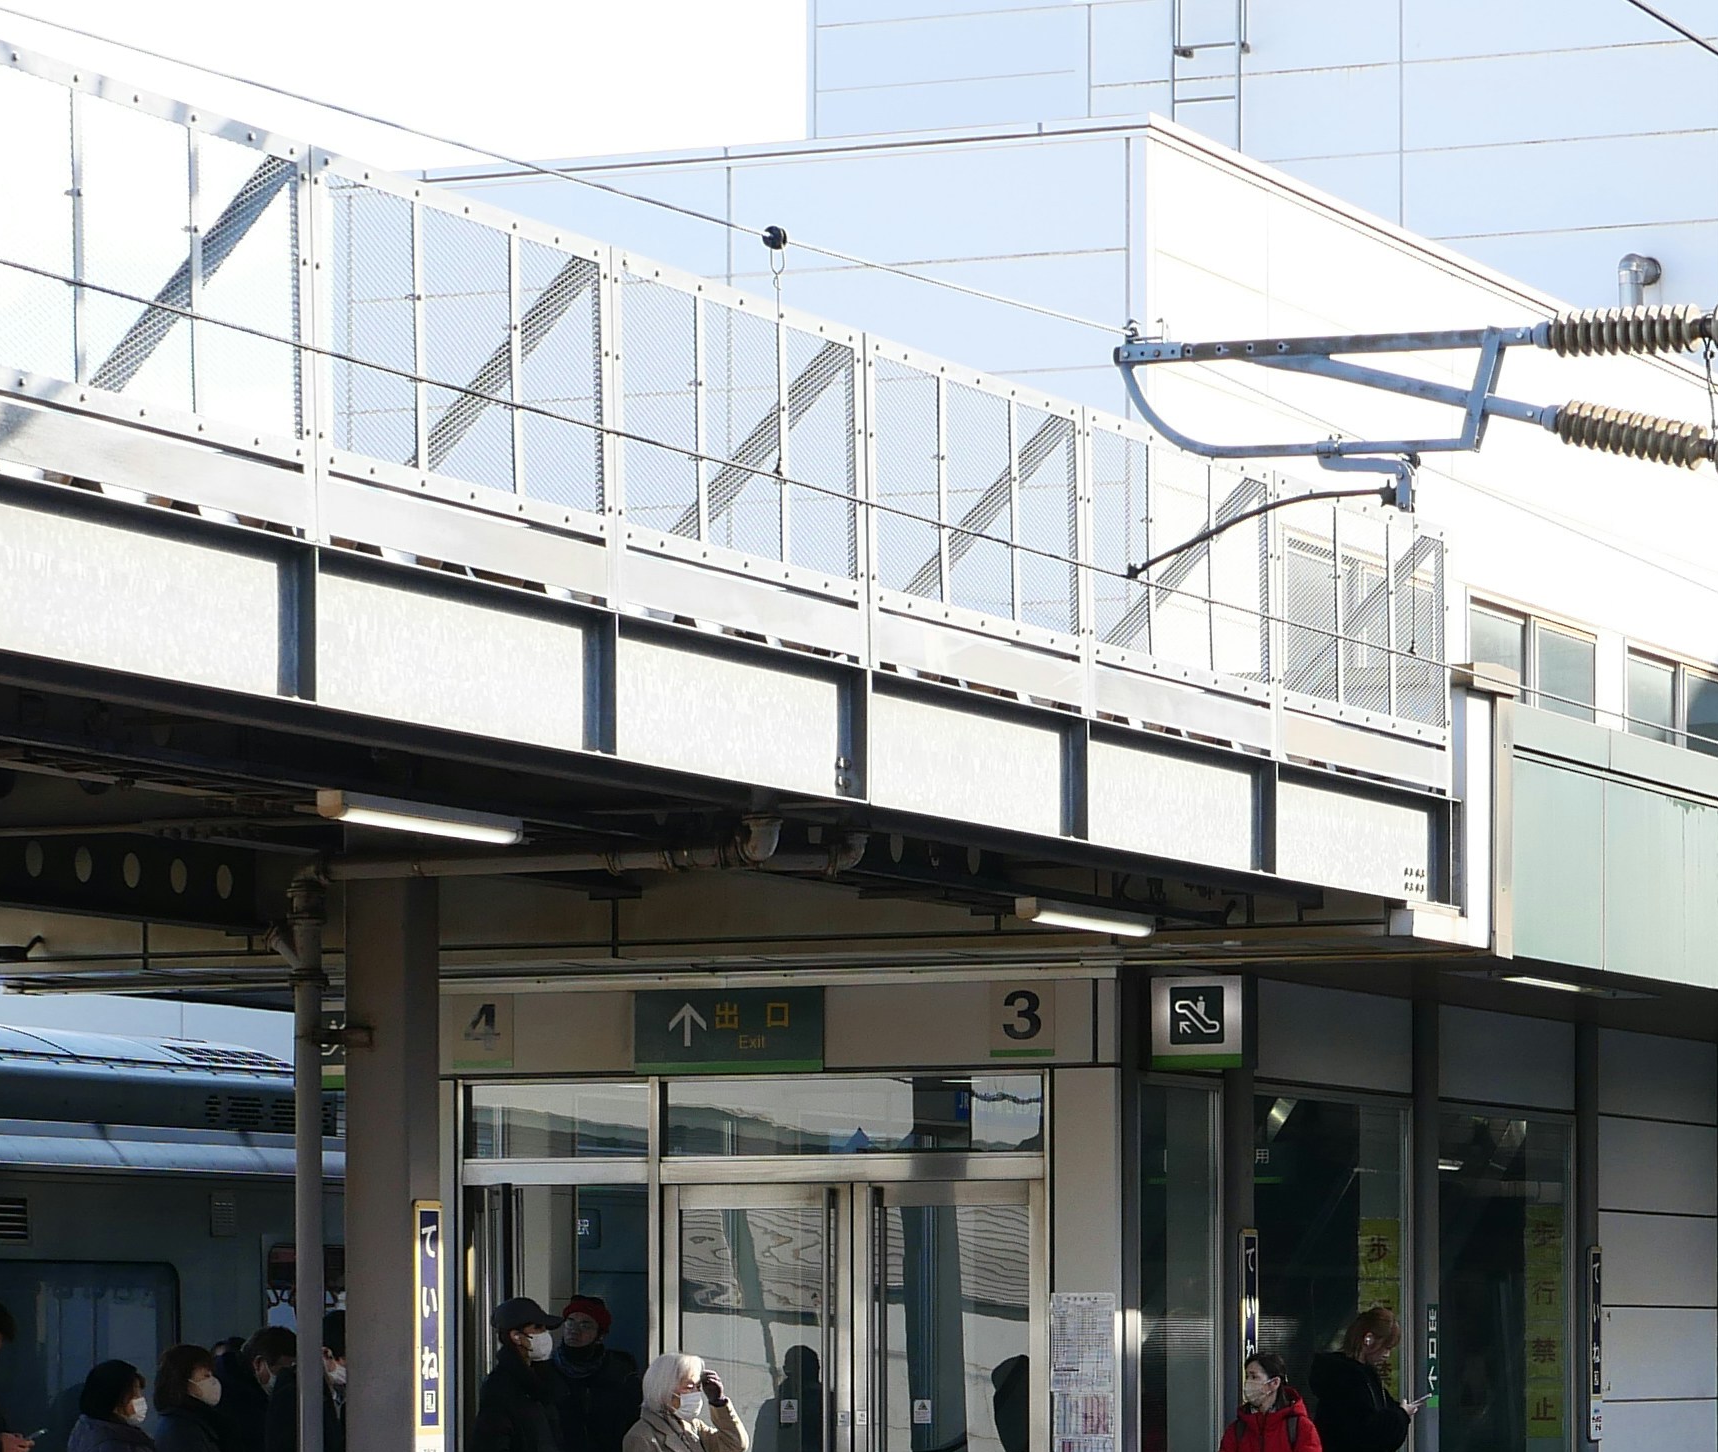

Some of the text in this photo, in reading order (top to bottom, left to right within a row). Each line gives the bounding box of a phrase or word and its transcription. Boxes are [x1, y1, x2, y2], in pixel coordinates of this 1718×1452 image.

[464, 1003, 501, 1051] 4
[714, 1002, 789, 1030] 出口
[1002, 989, 1042, 1041] 3
[738, 1034, 765, 1050] Exit
[421, 1225, 439, 1380] ていね
[1532, 1220, 1557, 1421] 歩行禁止
[1428, 1308, 1437, 1359] 出口
